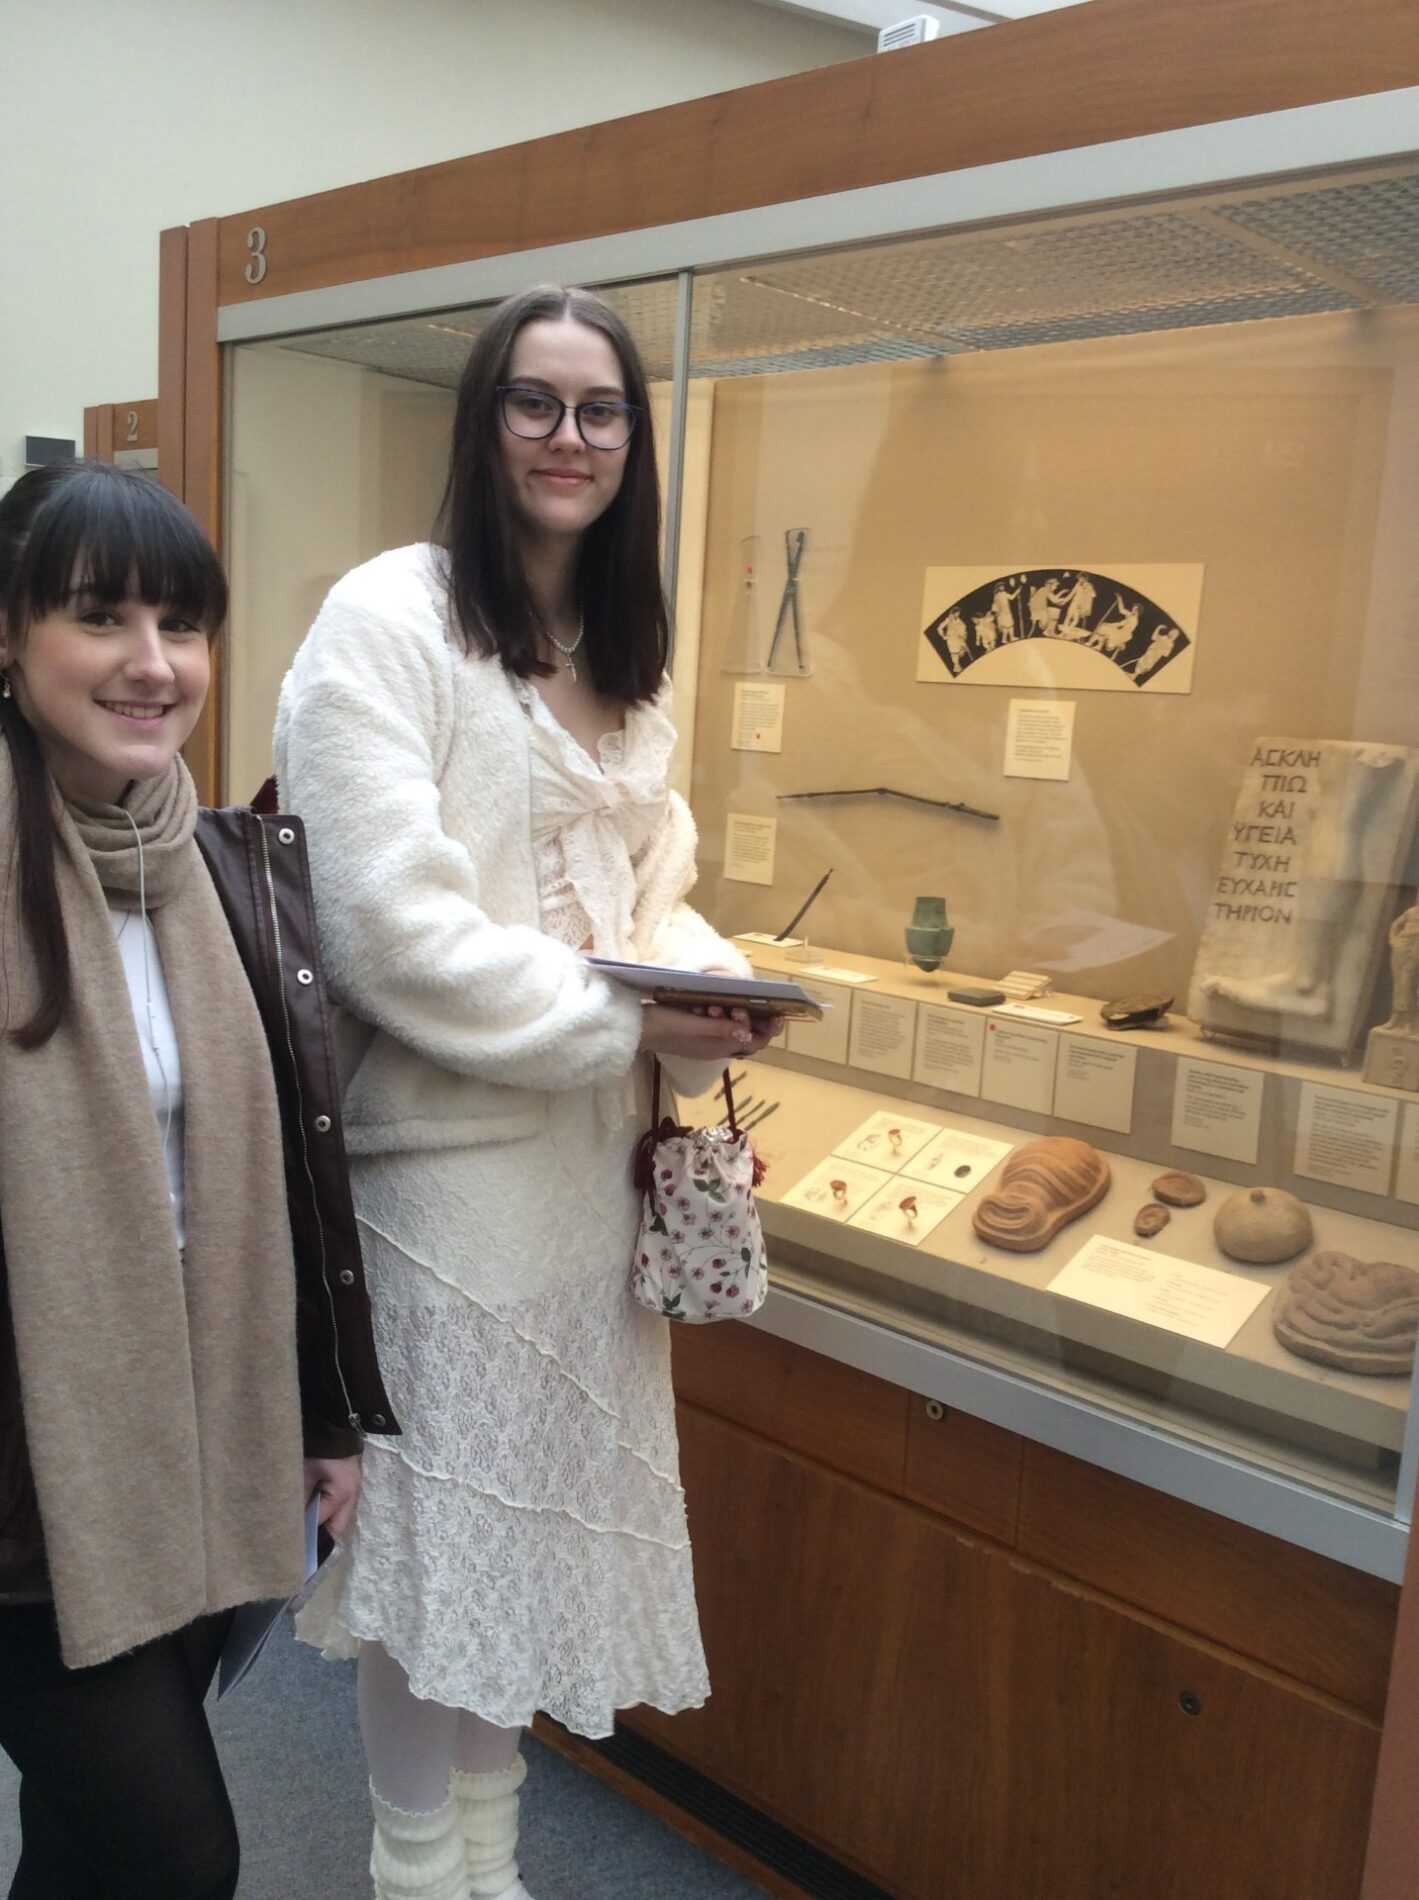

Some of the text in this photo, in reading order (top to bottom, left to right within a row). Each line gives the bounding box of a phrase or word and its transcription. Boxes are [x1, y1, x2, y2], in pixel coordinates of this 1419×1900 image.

[245, 227, 267, 284] 3
[126, 411, 138, 442] 2
[1261, 774, 1308, 793] ΠΙΩ
[1233, 852, 1292, 873] ΤΥΧΗ
